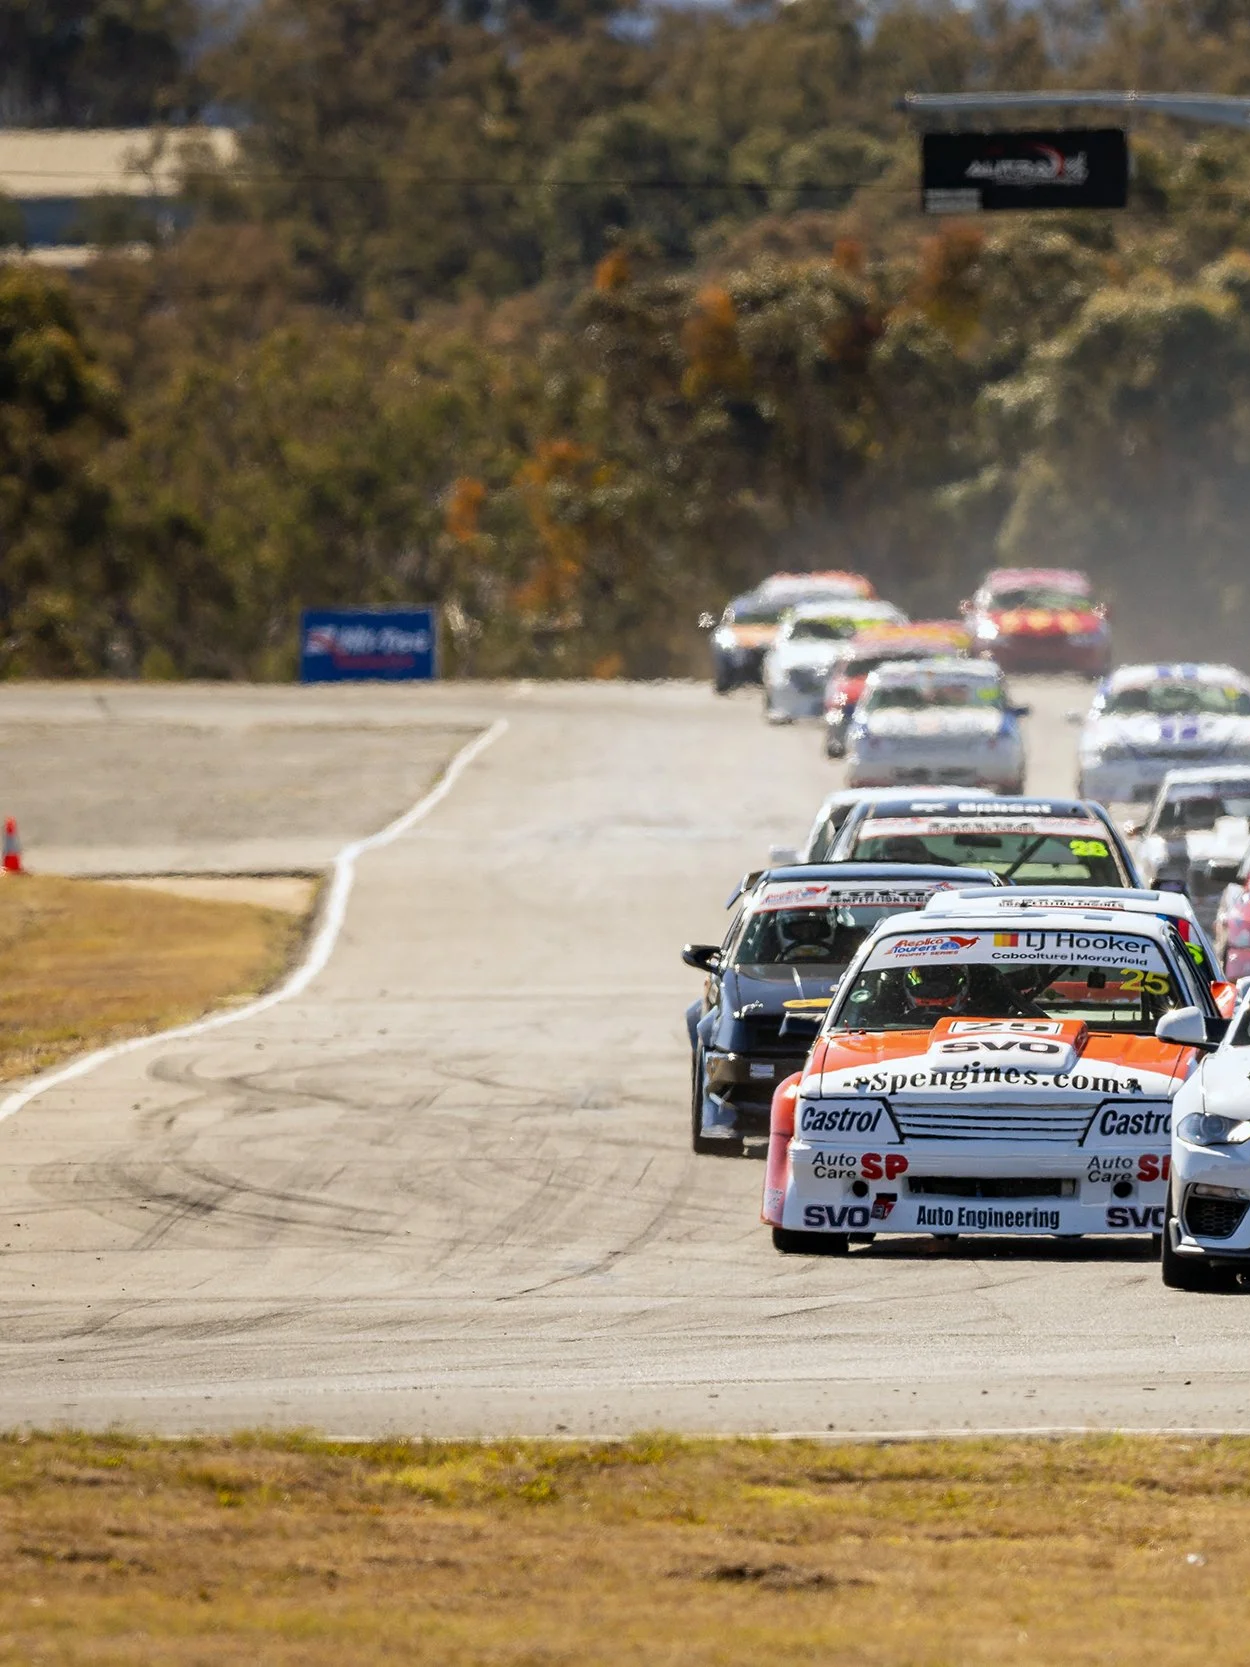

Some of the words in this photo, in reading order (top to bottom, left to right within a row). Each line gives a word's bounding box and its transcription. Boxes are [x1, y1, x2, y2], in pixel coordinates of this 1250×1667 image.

[893, 944, 938, 954] Tourers
[897, 938, 944, 948] Replica
[1026, 932, 1046, 952] LJ
[1055, 932, 1151, 954] Hooker
[991, 952, 1068, 960] Caboolture
[1076, 953, 1148, 967] Morayfield
[1120, 967, 1171, 996] 25
[941, 1041, 1060, 1054] SVO
[801, 1107, 883, 1133] Castrol
[811, 1151, 857, 1167] Auto
[860, 1152, 909, 1181] SP
[1086, 1155, 1133, 1169] Auto
[814, 1166, 857, 1180] Care
[1087, 1170, 1133, 1183] Care
[803, 1205, 871, 1229] SVO
[916, 1204, 955, 1227] Auto
[957, 1206, 1061, 1231] Engineering
